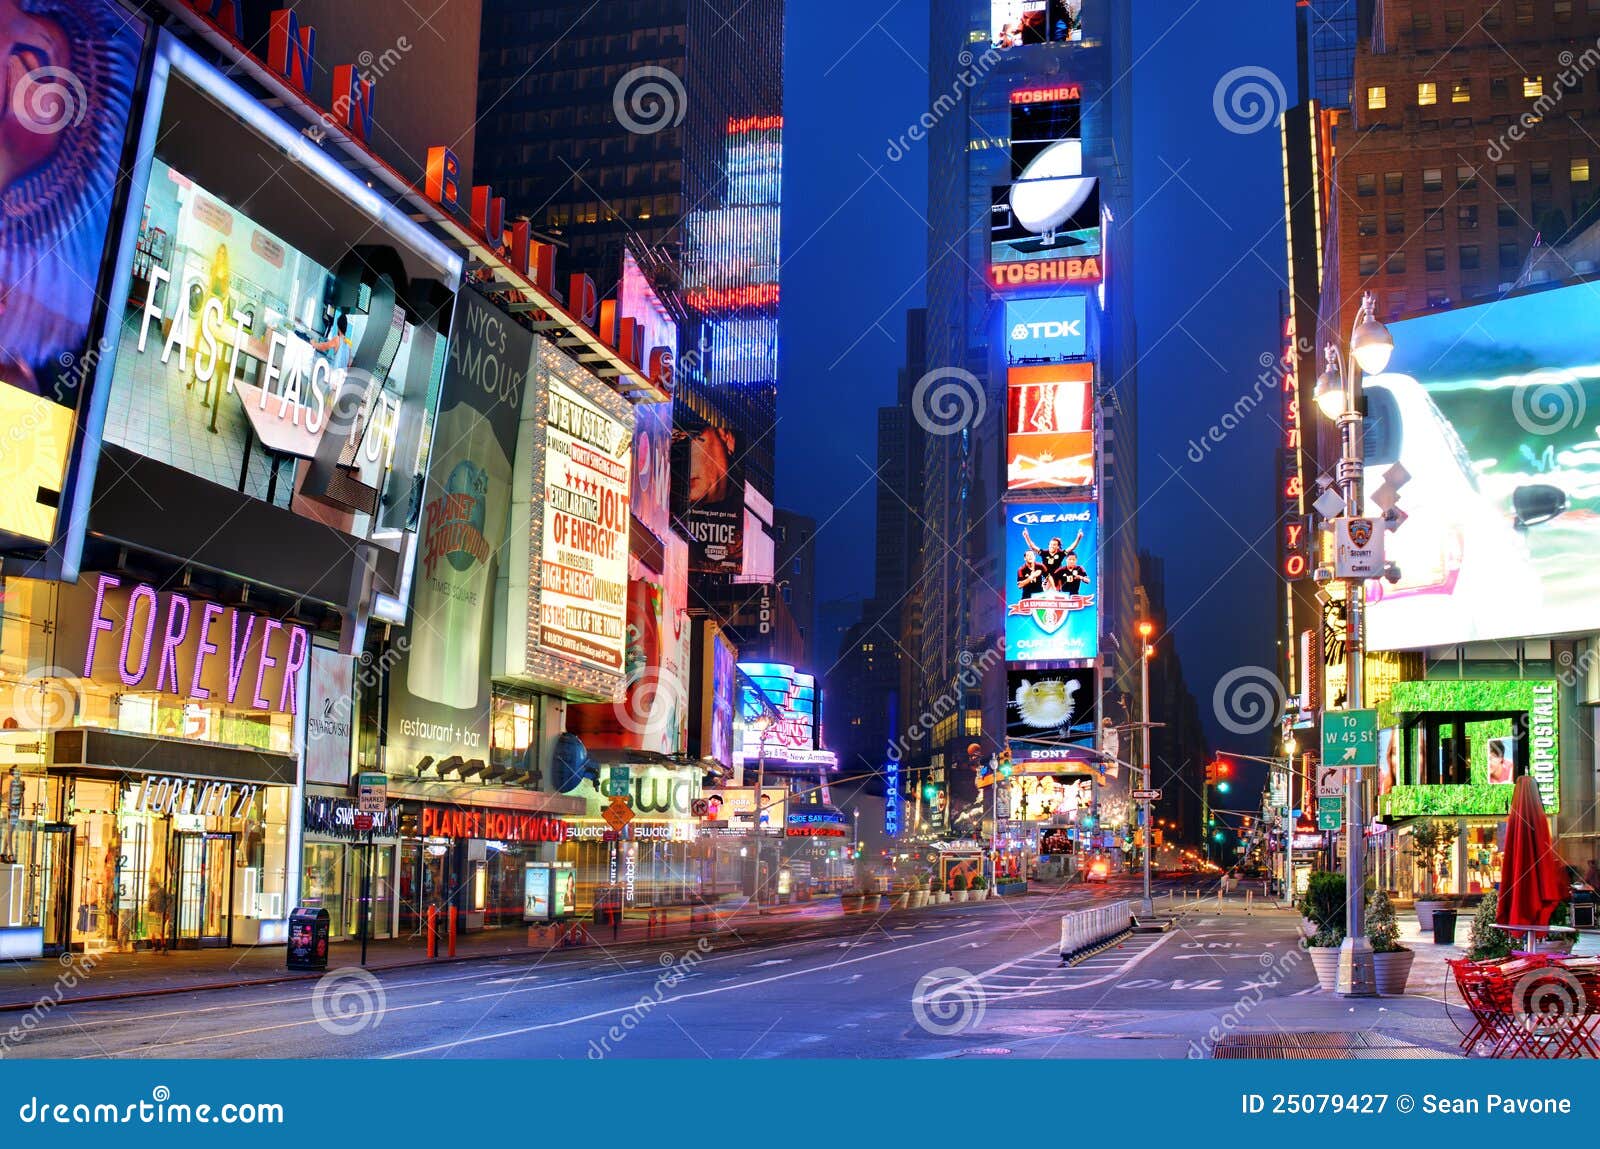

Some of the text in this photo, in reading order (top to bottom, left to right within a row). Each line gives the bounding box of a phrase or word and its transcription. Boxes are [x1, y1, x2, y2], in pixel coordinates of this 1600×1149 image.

[1012, 87, 1080, 104] TOSHIBA
[991, 258, 1100, 284] TOSHIBA
[137, 264, 254, 395] FAST
[466, 302, 507, 354] NYC's
[1027, 320, 1081, 338] TDK
[450, 332, 522, 409] AMOUS
[547, 390, 611, 453] NEWSIES
[552, 437, 572, 457] MUSICAL
[597, 485, 630, 536] JOLT
[424, 523, 490, 579] HOLLYWOOD
[554, 512, 616, 561] OF ENERGY!
[565, 551, 594, 571] IRRESISTIBLE
[541, 563, 594, 598] HIGH-ENERGY
[759, 584, 770, 634] 1500
[83, 573, 308, 715] FOREVER
[308, 718, 349, 738] SWAROVSKI
[400, 717, 453, 744] restaurant
[464, 726, 480, 748] bar
[1325, 731, 1374, 744] W 45 St
[1342, 716, 1357, 728] To
[1031, 749, 1070, 759] SONY
[138, 776, 257, 818] FOREVER 21
[422, 808, 567, 843] PLANET HOLLYWOOD
[626, 855, 635, 901] swatch
